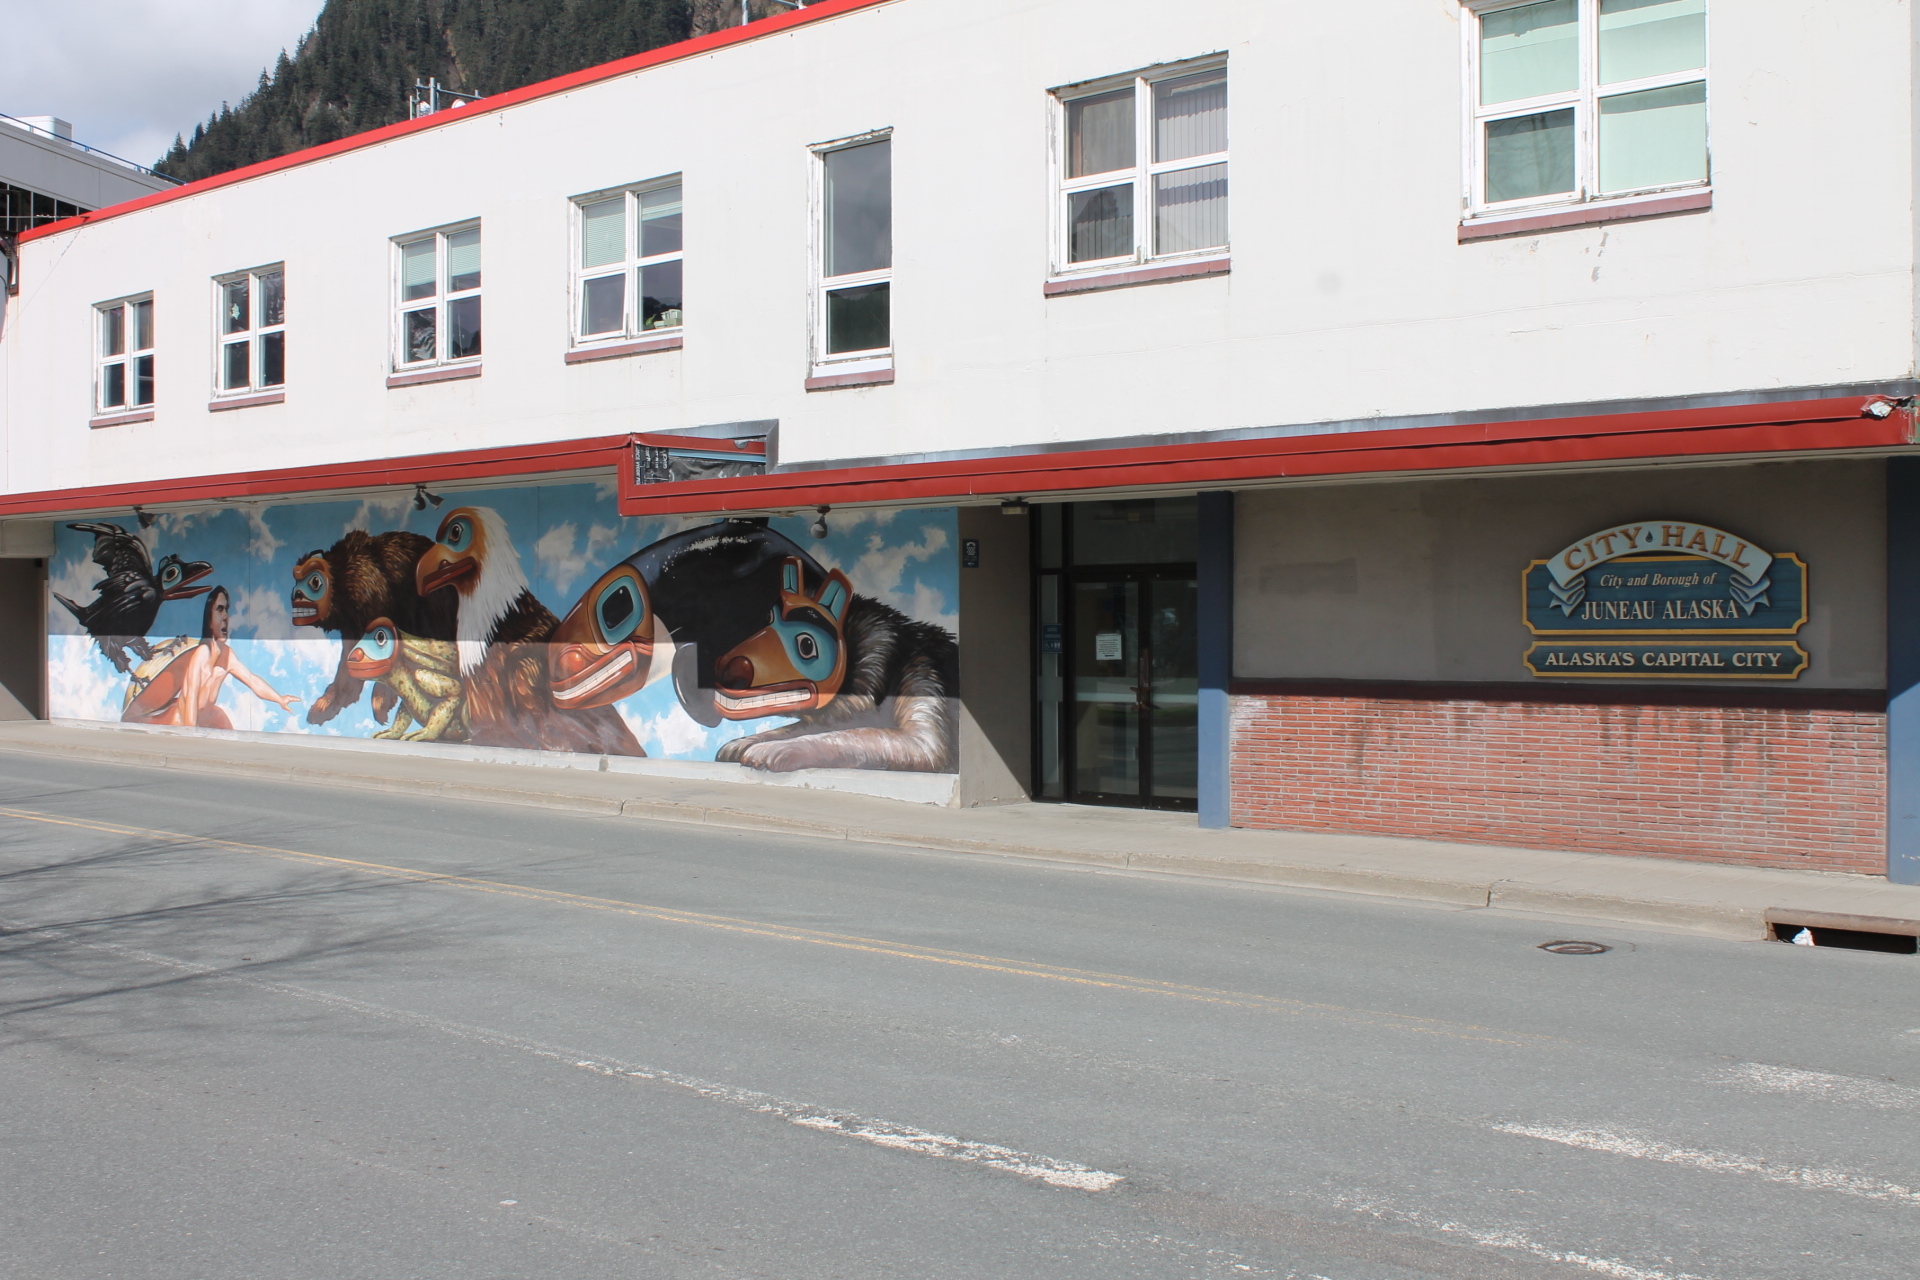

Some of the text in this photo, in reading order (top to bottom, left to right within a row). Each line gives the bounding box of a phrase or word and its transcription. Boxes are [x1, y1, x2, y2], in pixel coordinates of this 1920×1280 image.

[1564, 524, 1750, 571] CITY HALL
[1600, 573, 1717, 588] City and Borough of
[1581, 599, 1739, 620] JUNEAU ALASKA
[1545, 651, 1782, 667] ALASKA'S CAPITAL CITY
